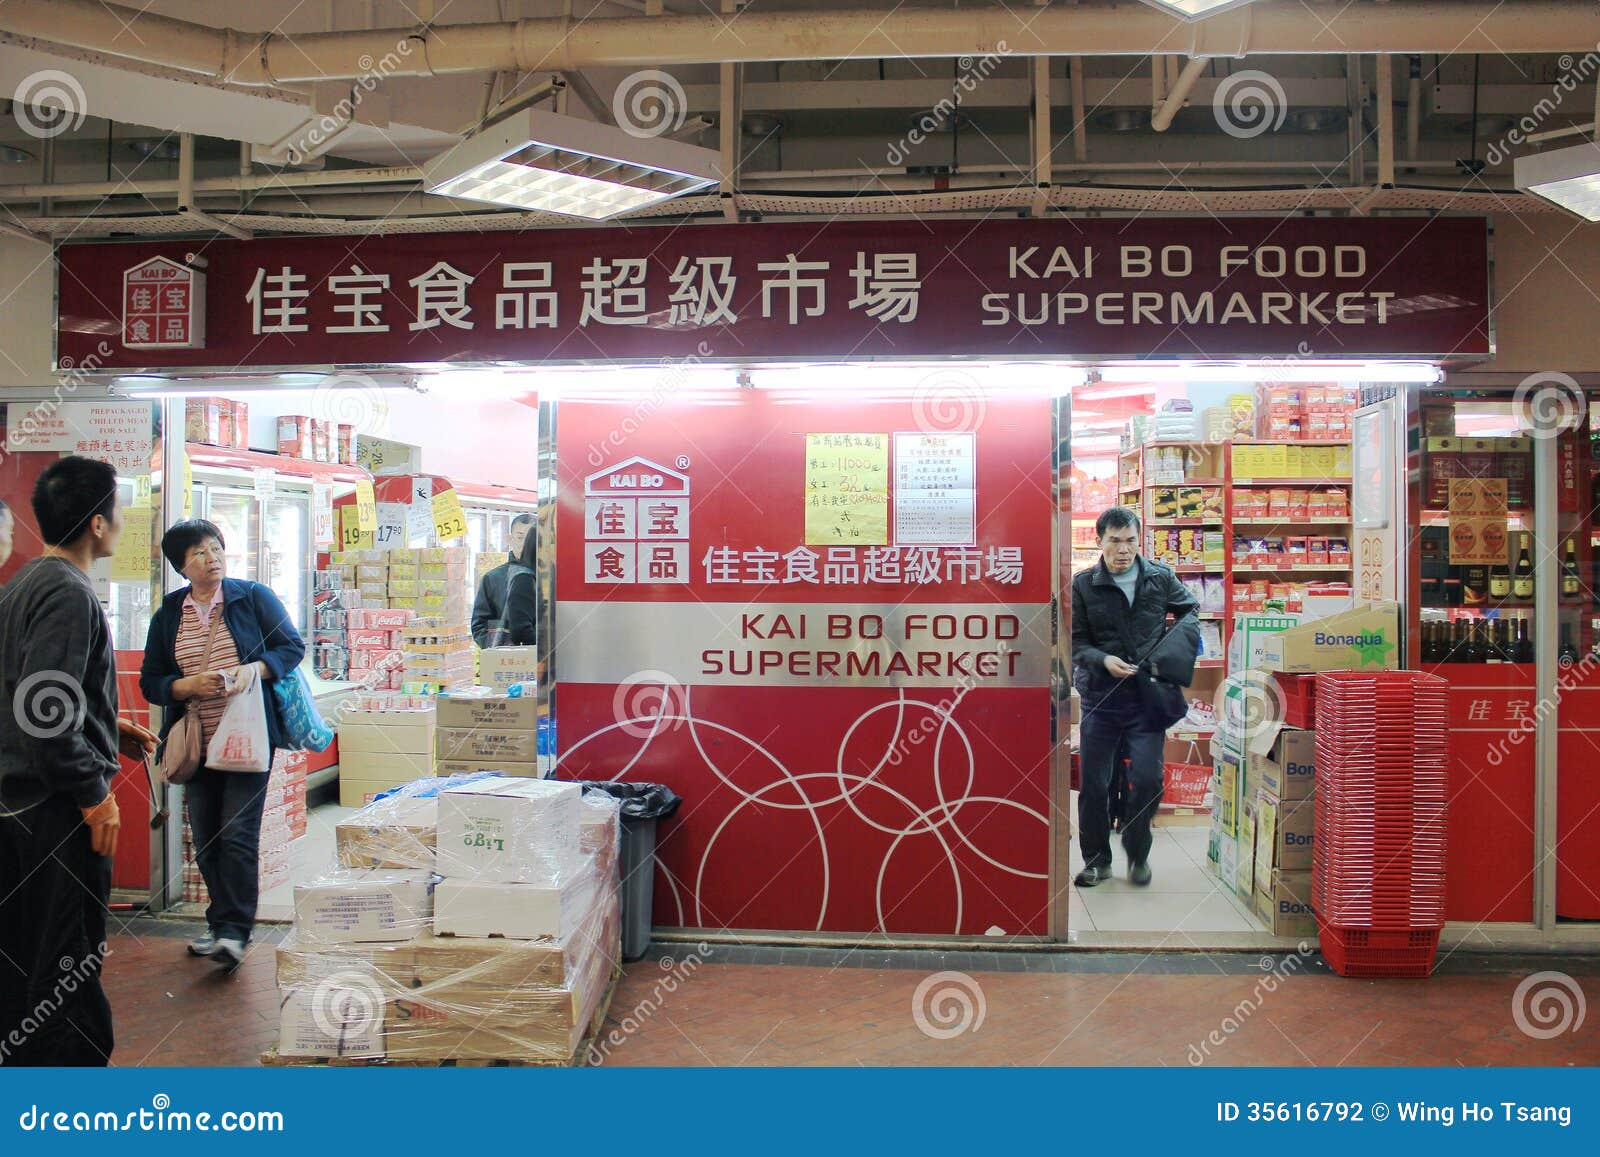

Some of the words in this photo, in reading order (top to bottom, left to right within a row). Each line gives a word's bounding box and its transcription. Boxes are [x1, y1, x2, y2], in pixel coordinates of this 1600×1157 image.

[141, 269, 159, 278] KAI
[162, 268, 177, 278] BO
[1008, 246, 1092, 280] KAI
[1120, 245, 1193, 279] BO
[1220, 244, 1367, 279] FOOD
[246, 251, 922, 336] 佳宝食品超級市場
[980, 290, 1395, 326] SUPERMARKET
[609, 474, 637, 487] KAI
[640, 474, 664, 487] BO
[701, 545, 1025, 585] 佳宝食品超級市場
[741, 613, 806, 640] KAI
[827, 613, 883, 640] BO
[904, 613, 1020, 640] FOOD
[1314, 632, 1382, 648] Bonaqua
[701, 649, 1022, 677] SUPERMARKET
[1468, 699, 1530, 720] 佳宝
